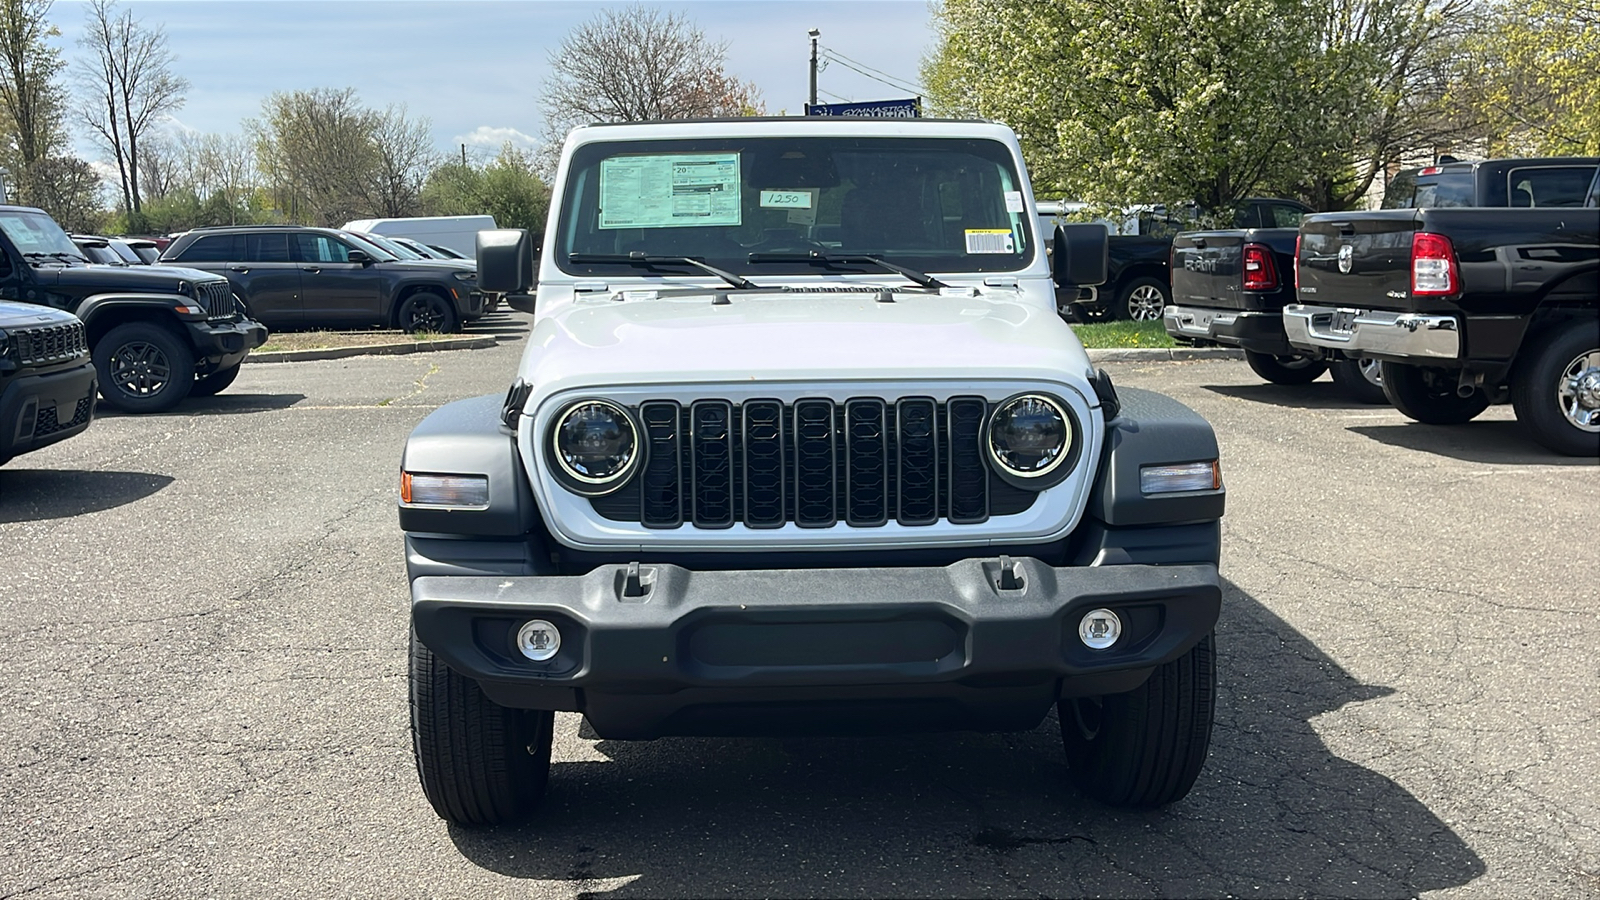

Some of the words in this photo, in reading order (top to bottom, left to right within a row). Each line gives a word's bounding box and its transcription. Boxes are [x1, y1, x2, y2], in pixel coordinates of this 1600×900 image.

[842, 105, 911, 116] GYMNASTICS
[768, 194, 799, 204] 1250
[1184, 260, 1217, 272] RAM
